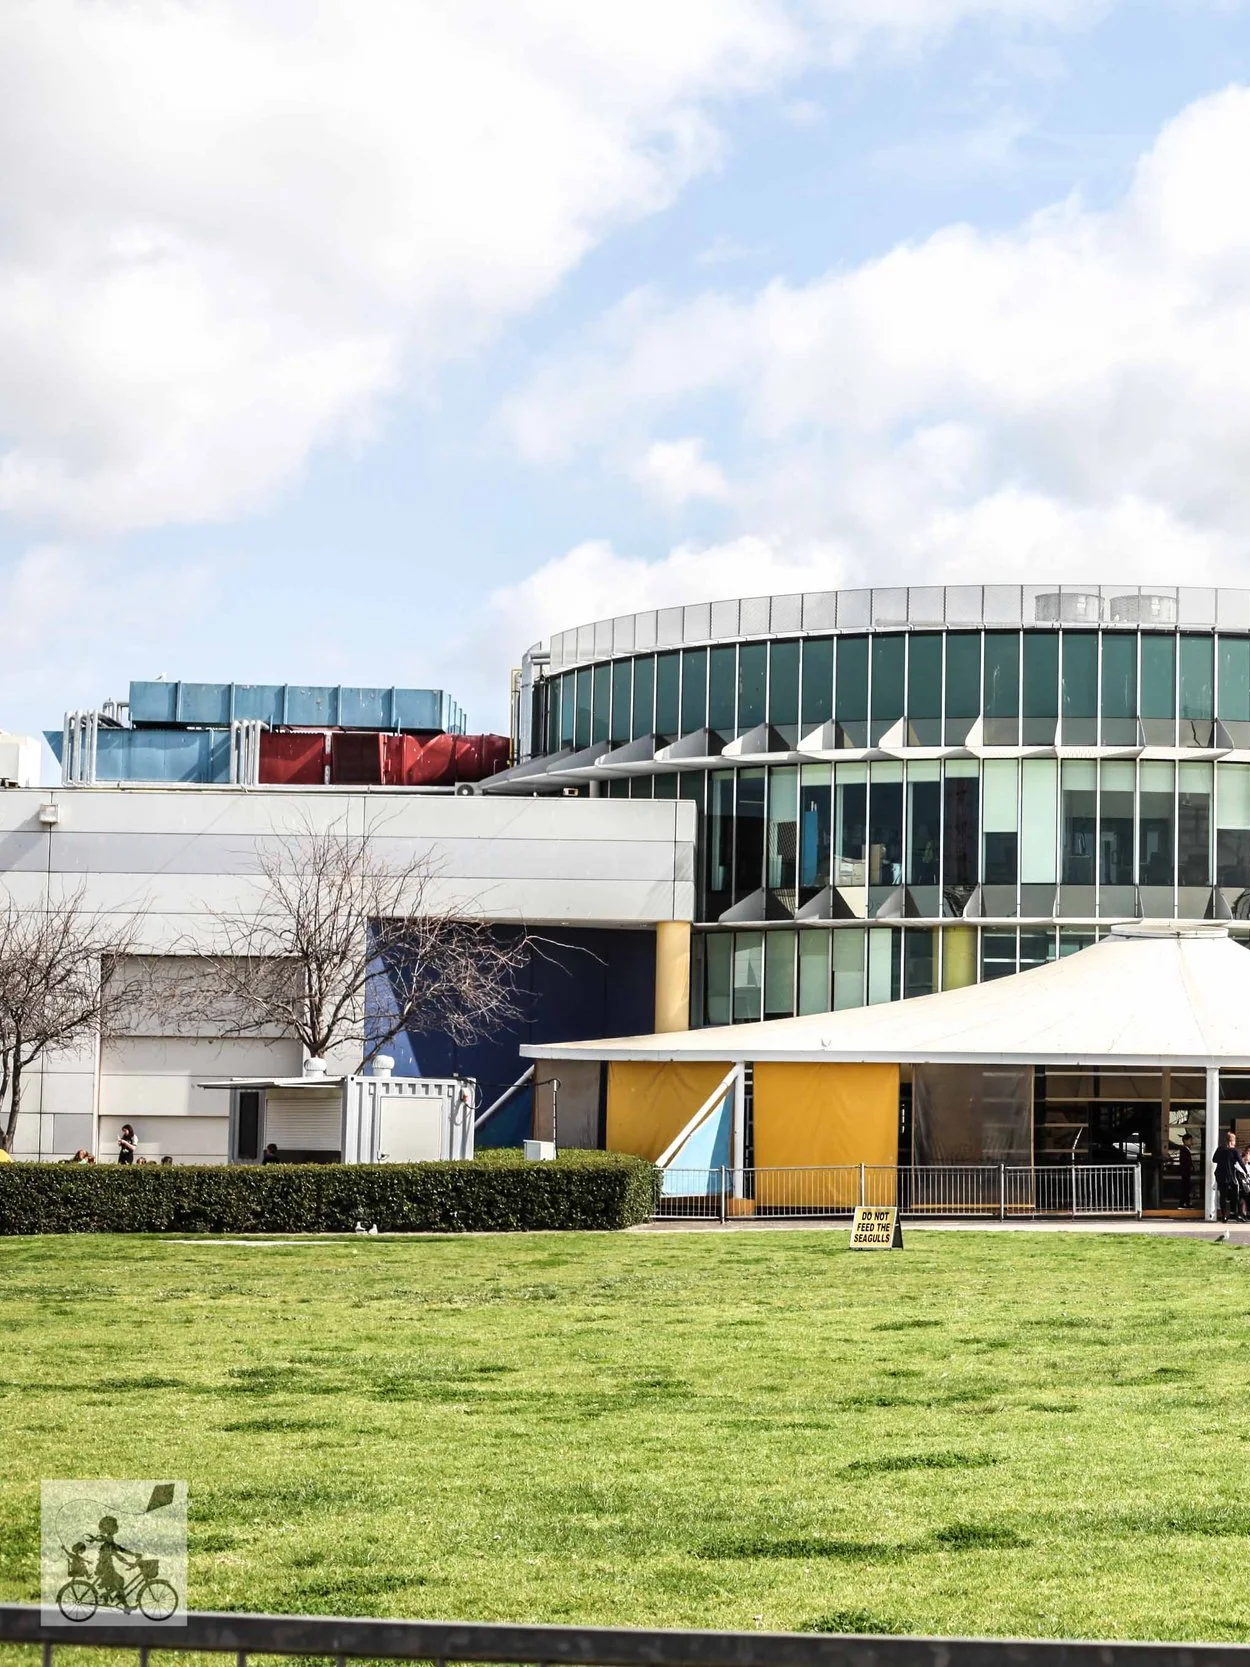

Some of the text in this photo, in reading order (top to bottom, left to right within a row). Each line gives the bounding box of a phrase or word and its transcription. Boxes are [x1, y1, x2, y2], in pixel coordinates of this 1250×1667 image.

[862, 1212, 890, 1221] DO NOT
[857, 1223, 890, 1232] FEED THE
[854, 1234, 890, 1243] SEAGULLS
